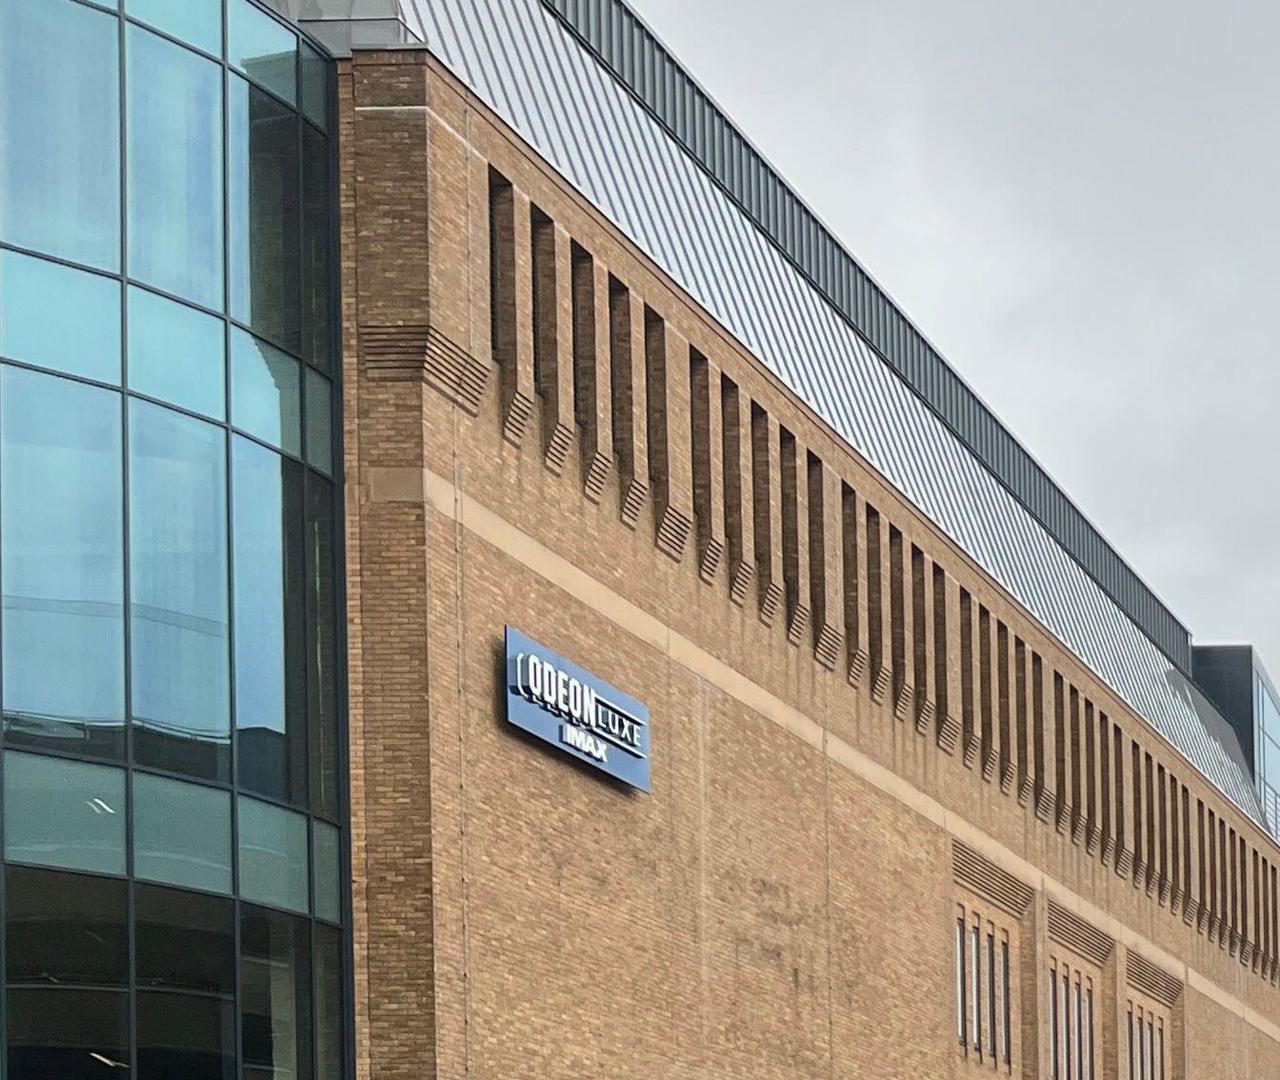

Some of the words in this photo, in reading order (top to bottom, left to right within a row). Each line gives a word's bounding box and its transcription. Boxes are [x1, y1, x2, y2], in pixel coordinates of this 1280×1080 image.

[528, 654, 597, 729] ODEON
[597, 702, 642, 748] LUXE
[563, 724, 608, 763] IMAX
